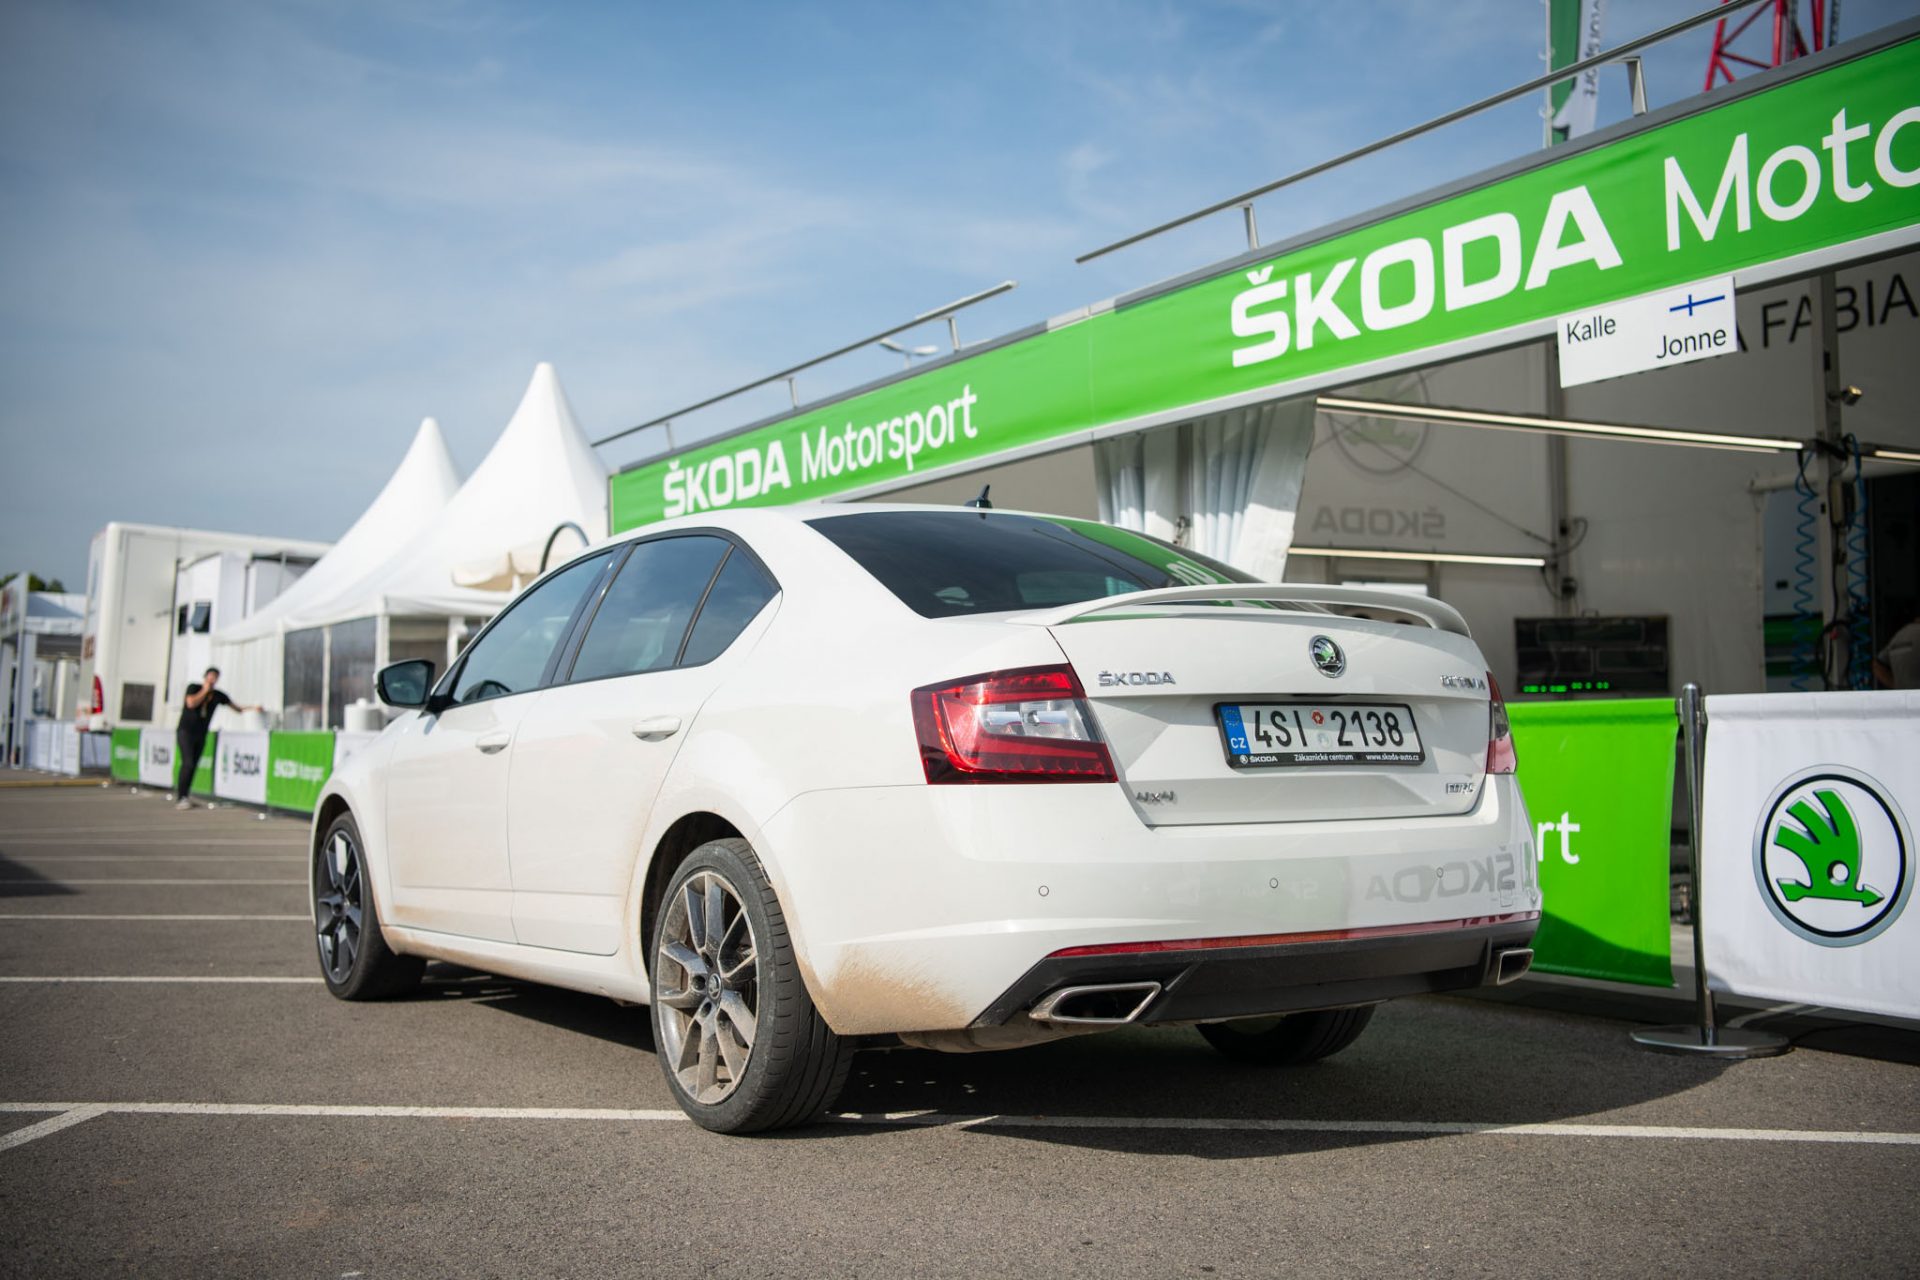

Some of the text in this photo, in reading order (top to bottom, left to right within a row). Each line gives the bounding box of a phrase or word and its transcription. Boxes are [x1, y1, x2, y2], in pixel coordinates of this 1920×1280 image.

[1230, 184, 1624, 368] ŠKODA
[1566, 315, 1617, 344] Kalle
[1656, 328, 1727, 359] Jonne
[662, 384, 978, 519] ŠKODA Motorsport
[1098, 670, 1177, 687] ŠKODA
[1230, 737, 1247, 749] CZ
[1330, 710, 1405, 747] 2138
